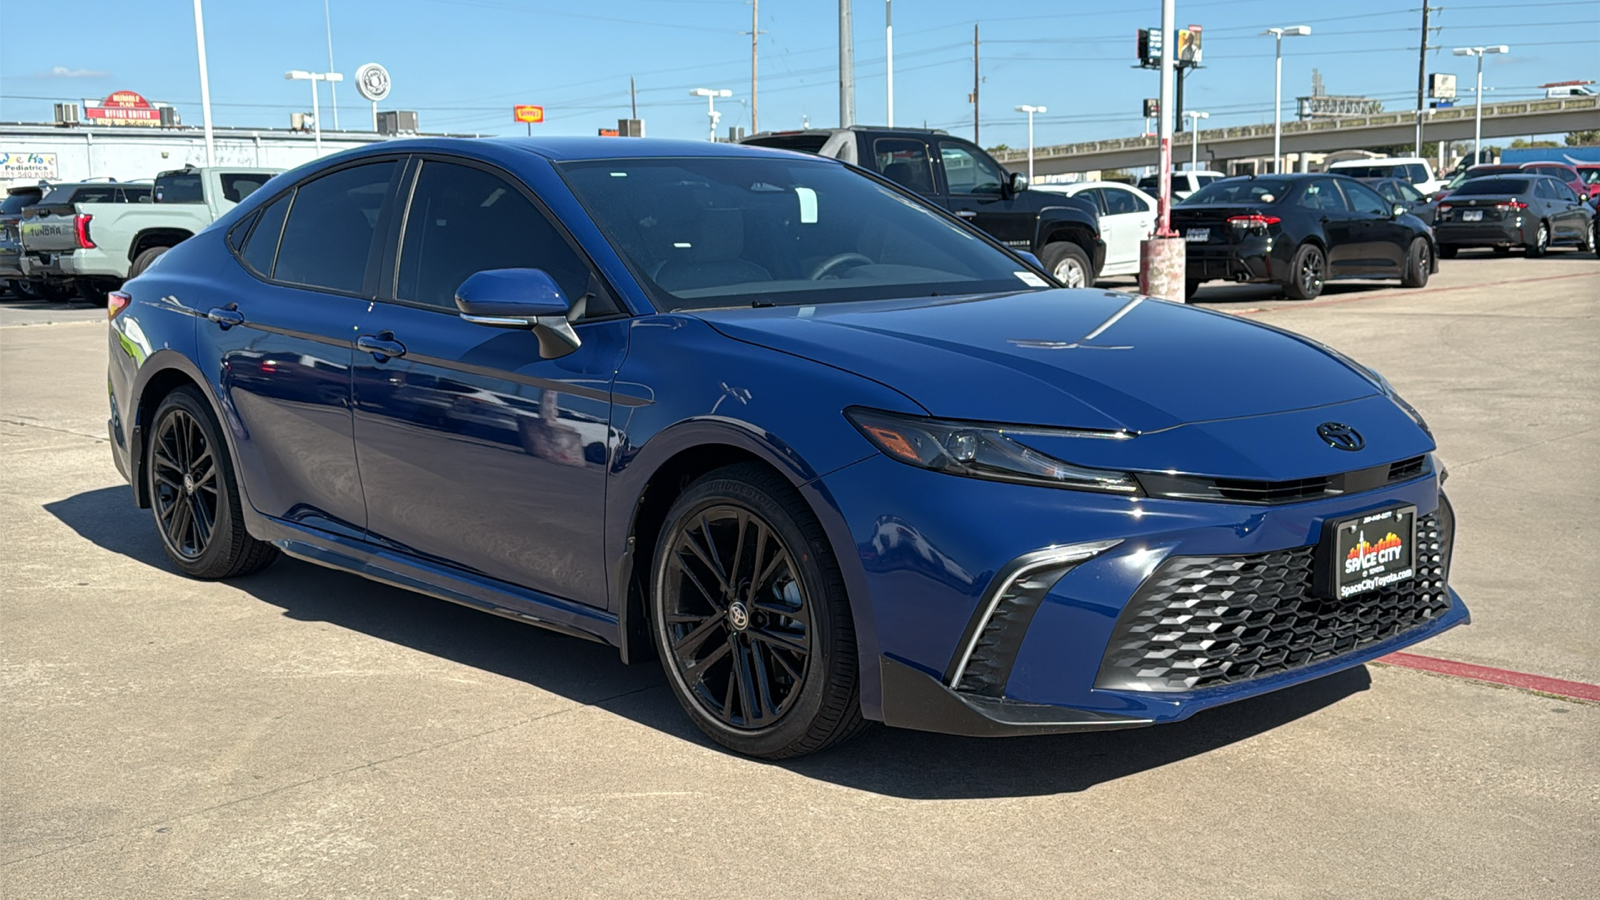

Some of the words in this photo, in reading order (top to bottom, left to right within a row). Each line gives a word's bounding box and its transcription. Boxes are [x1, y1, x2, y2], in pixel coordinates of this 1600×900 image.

[30, 227, 62, 237] TUNDRA
[1345, 552, 1378, 573] SPACE
[1378, 546, 1402, 563] CITY
[1341, 569, 1412, 597] SpaceCityToyota.com
